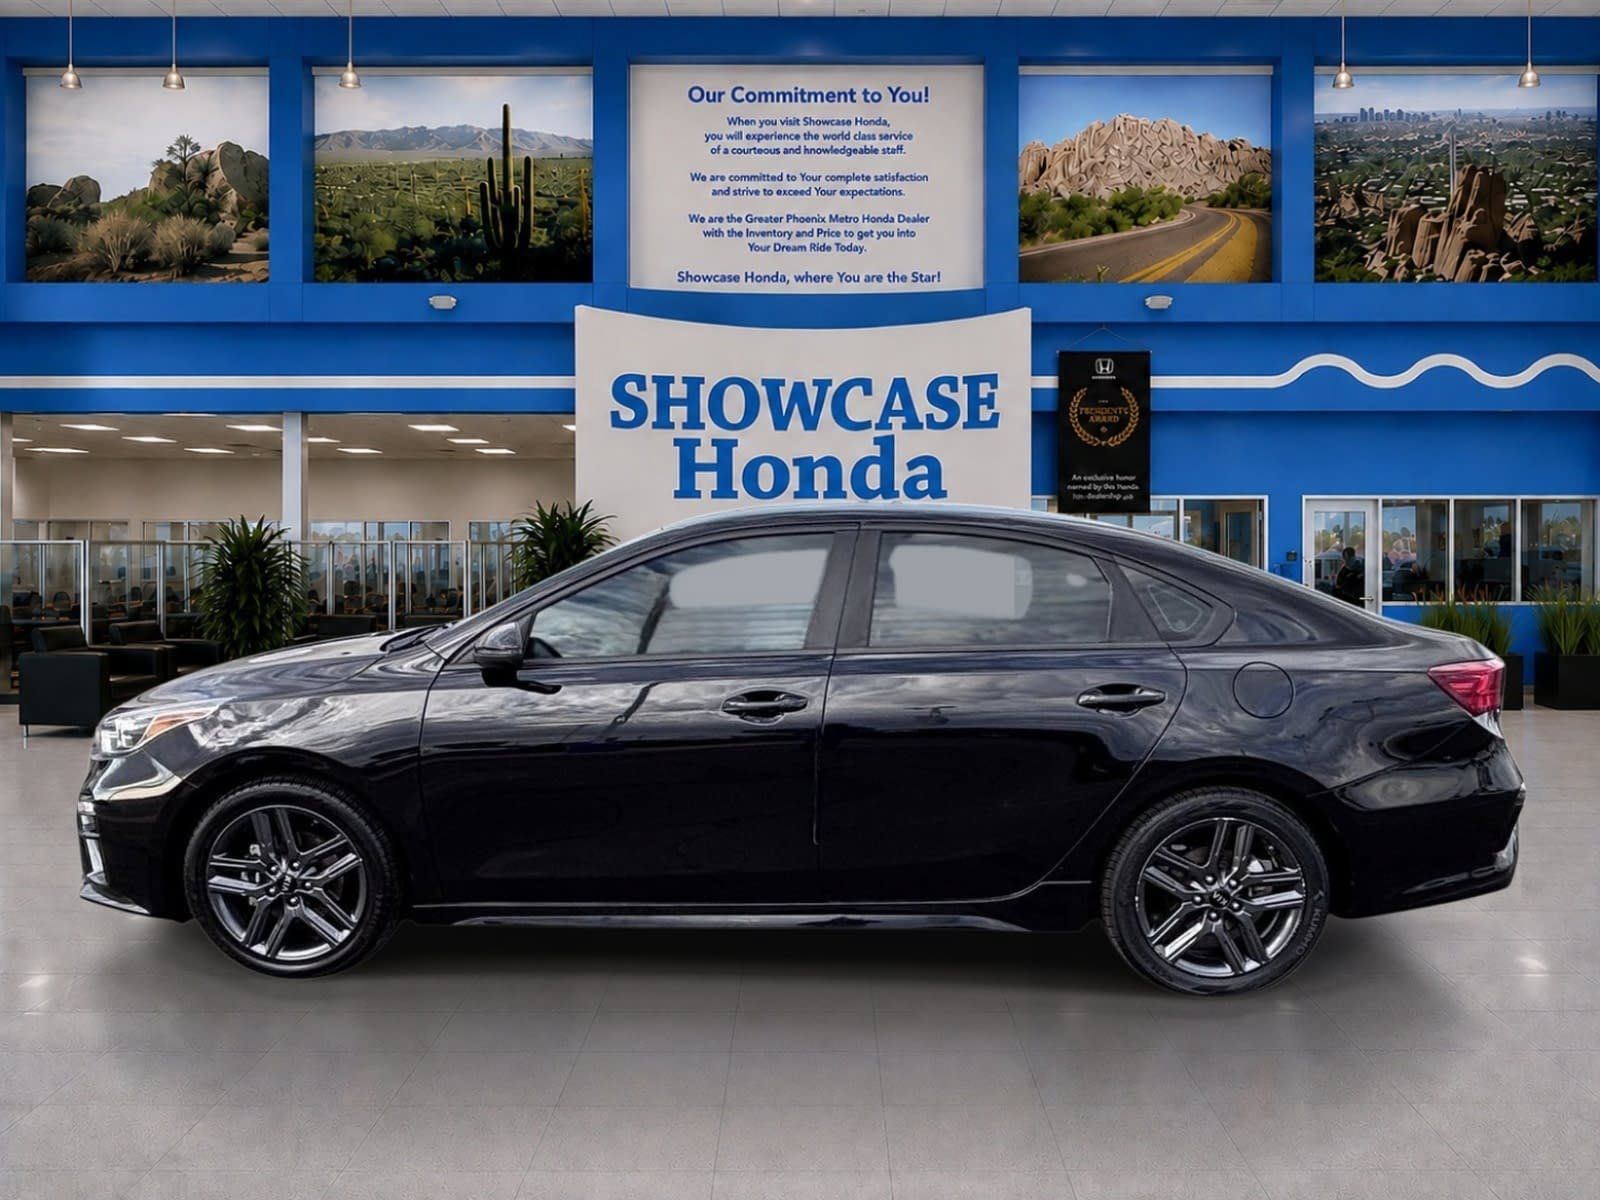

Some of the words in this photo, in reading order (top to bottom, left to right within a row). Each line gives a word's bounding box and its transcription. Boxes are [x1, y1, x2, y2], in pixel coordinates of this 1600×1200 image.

[687, 85, 727, 104] Our
[730, 85, 857, 104] Commitment
[861, 87, 883, 104] to
[886, 85, 930, 104] You!
[726, 115, 757, 127] When
[758, 118, 778, 129] you
[779, 116, 801, 127] visit
[802, 116, 853, 127] Showcase
[854, 116, 891, 128] Honda,
[704, 132, 724, 144] you
[724, 130, 744, 141] will
[745, 130, 802, 144] experience
[802, 130, 820, 142] the
[821, 130, 851, 142] world
[852, 130, 877, 142] class
[878, 130, 914, 142] service
[709, 144, 722, 155] of
[722, 147, 730, 155] a
[730, 146, 781, 156] courteous
[782, 144, 802, 155] and
[689, 171, 708, 183] We
[709, 174, 727, 183] are
[727, 171, 784, 183] committed
[785, 173, 798, 183] to
[799, 172, 823, 183] Your
[824, 171, 872, 185] complete
[873, 171, 929, 183] satisfaction
[711, 186, 731, 197] and
[732, 186, 761, 197] strive
[762, 187, 775, 197] to
[775, 186, 813, 197] exceed
[813, 186, 838, 197] Your
[838, 186, 906, 200] expectations.
[687, 213, 706, 224] We
[707, 215, 725, 224] are
[725, 213, 743, 224] the
[744, 213, 785, 224] Greater
[785, 213, 827, 224] Phoenix
[828, 213, 860, 224] Metro
[861, 213, 896, 224] Honda
[897, 213, 931, 224] Dealer
[702, 227, 725, 239] with
[726, 227, 744, 239] the
[745, 227, 794, 241] Inventory
[794, 227, 815, 239] and
[816, 227, 842, 239] Price
[843, 229, 855, 239] to
[856, 229, 875, 241] get
[875, 230, 895, 241] you
[896, 227, 917, 239] into
[747, 241, 772, 253] Your
[772, 242, 808, 253] Dream
[809, 241, 833, 253] Ride
[833, 241, 868, 255] Today.
[676, 270, 741, 284] Showcase
[744, 270, 790, 286] Honda,
[793, 270, 834, 284] where
[836, 271, 861, 284] You
[863, 273, 884, 284] are
[886, 270, 909, 284] the
[910, 270, 941, 284] Star!
[610, 372, 1001, 432] SHOWCASE
[672, 434, 948, 501] Honda
